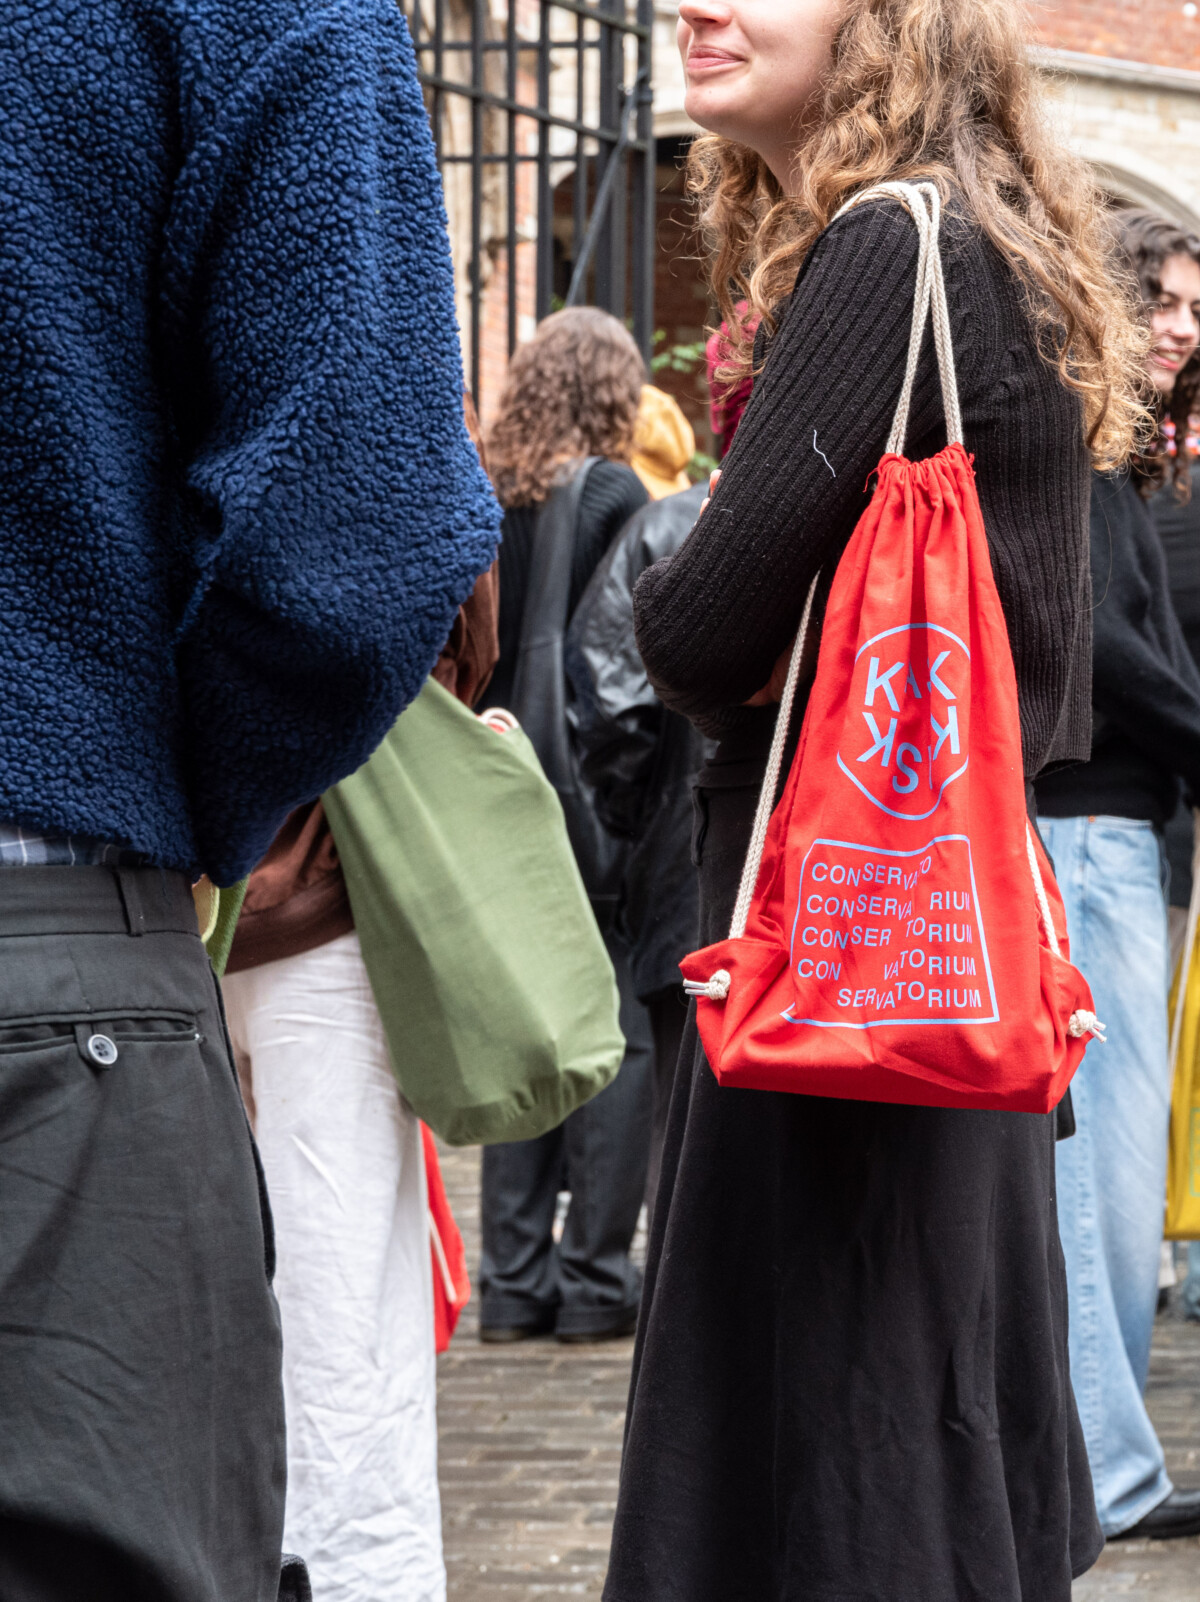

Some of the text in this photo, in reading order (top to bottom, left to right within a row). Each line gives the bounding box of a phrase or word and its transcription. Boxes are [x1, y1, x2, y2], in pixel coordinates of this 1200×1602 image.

[811, 855, 932, 891] CONSERVATO
[806, 894, 913, 921] CONSERVA
[802, 925, 892, 950] CONSER
[797, 948, 977, 981] CON VATORIUM
[836, 980, 983, 1010] SERVATORIUM
